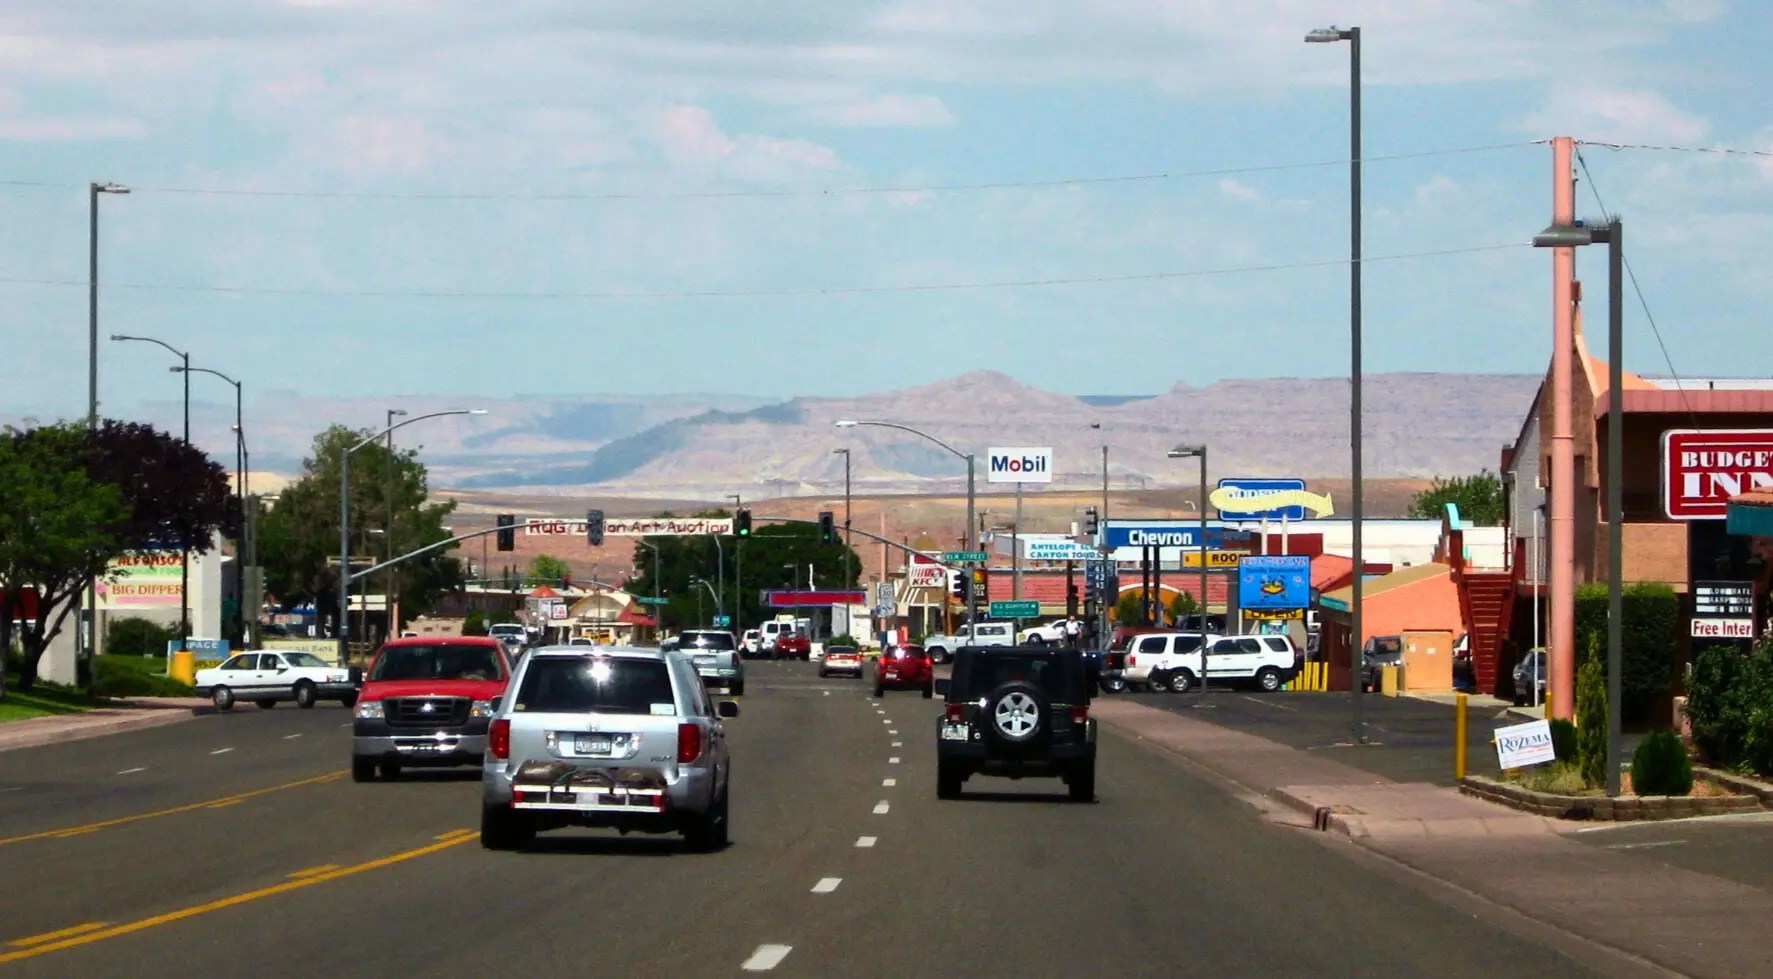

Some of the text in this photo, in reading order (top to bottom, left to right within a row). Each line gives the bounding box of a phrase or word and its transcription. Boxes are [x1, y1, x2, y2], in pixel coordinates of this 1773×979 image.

[991, 455, 1046, 472] Mobil
[1681, 451, 1773, 468] BUDGE
[529, 520, 729, 534] RUG Iian Art Auction
[1128, 529, 1192, 545] Chevron
[1212, 553, 1246, 566] ROO
[112, 584, 184, 595] BIG DIPPER
[1693, 621, 1751, 635] Free Inter
